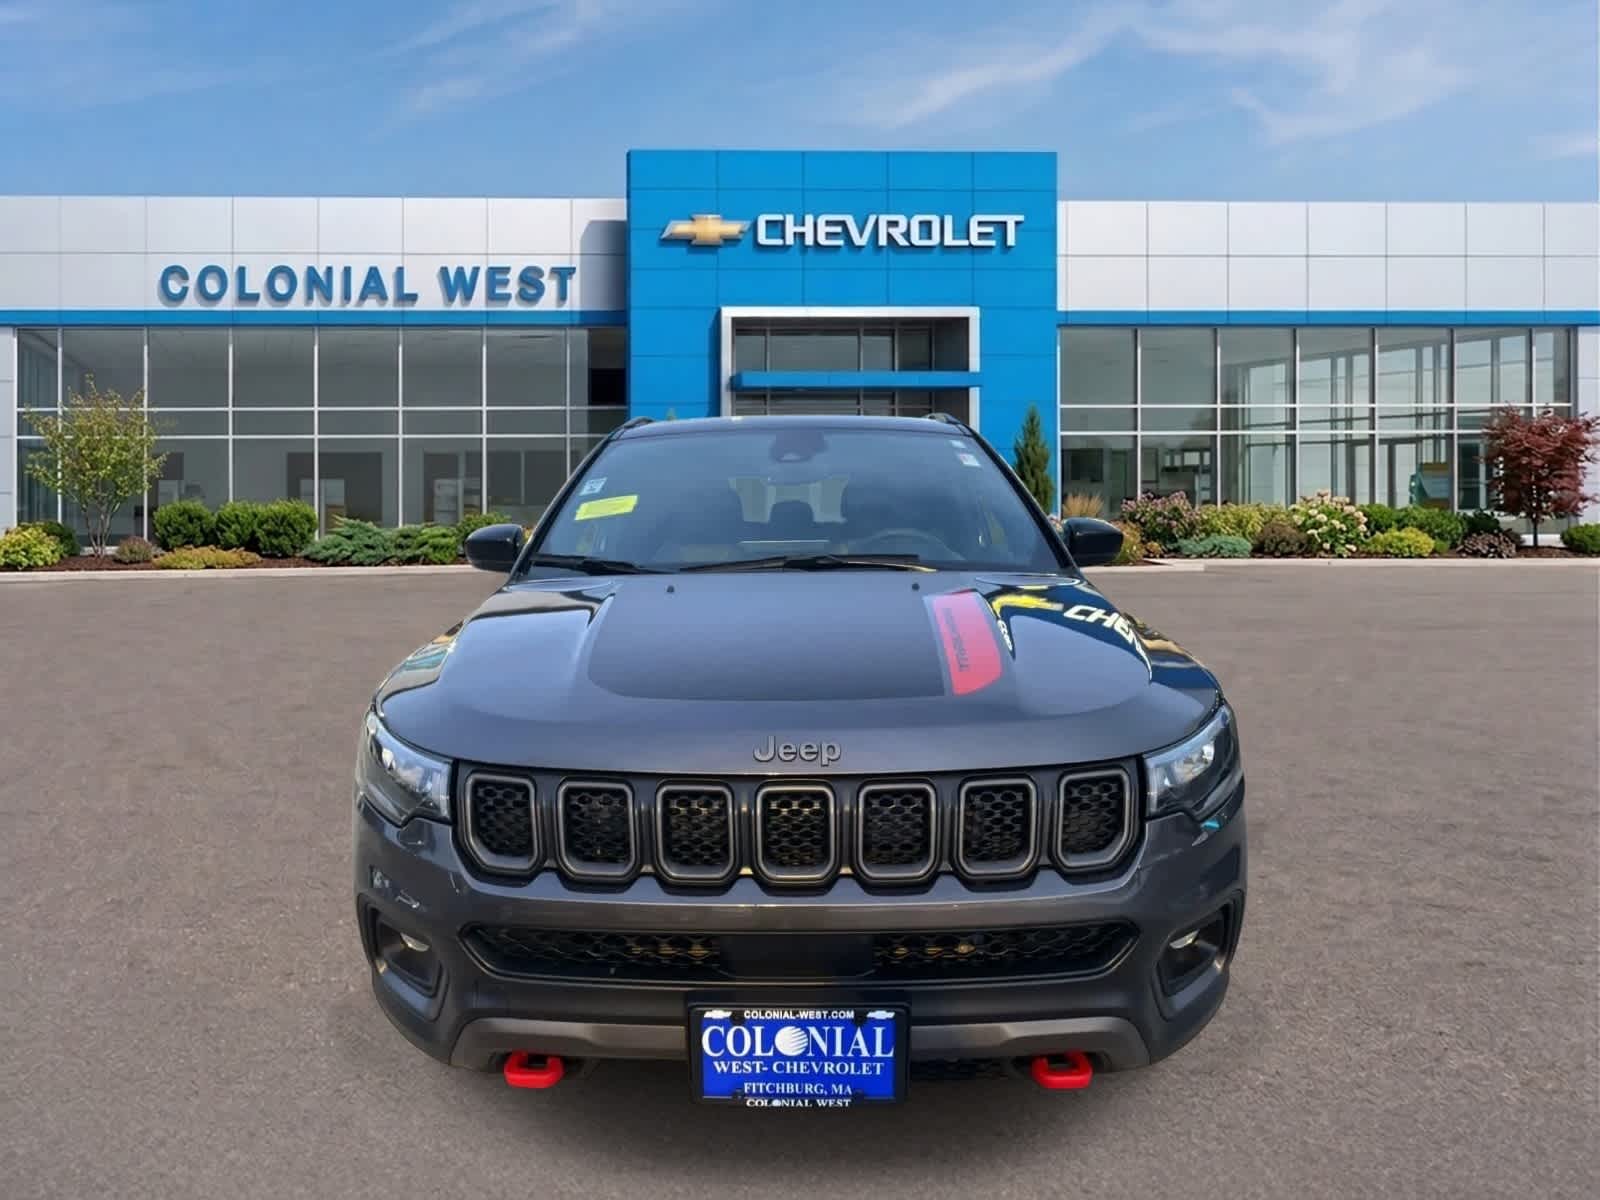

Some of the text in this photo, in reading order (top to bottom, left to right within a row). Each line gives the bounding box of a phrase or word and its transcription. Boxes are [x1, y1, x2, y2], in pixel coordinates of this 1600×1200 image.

[757, 214, 1025, 247] CHEVROLET
[159, 265, 577, 303] COLONIAL WEST
[753, 736, 841, 767] Jeep
[744, 1010, 854, 1020] COLONIAL-WEST.COM
[702, 1025, 894, 1057] COLONIAL
[773, 1061, 885, 1075] CHEVROLET
[744, 1082, 853, 1096] FITCHBURG, MA
[746, 1099, 851, 1107] COLONIAL WEST
